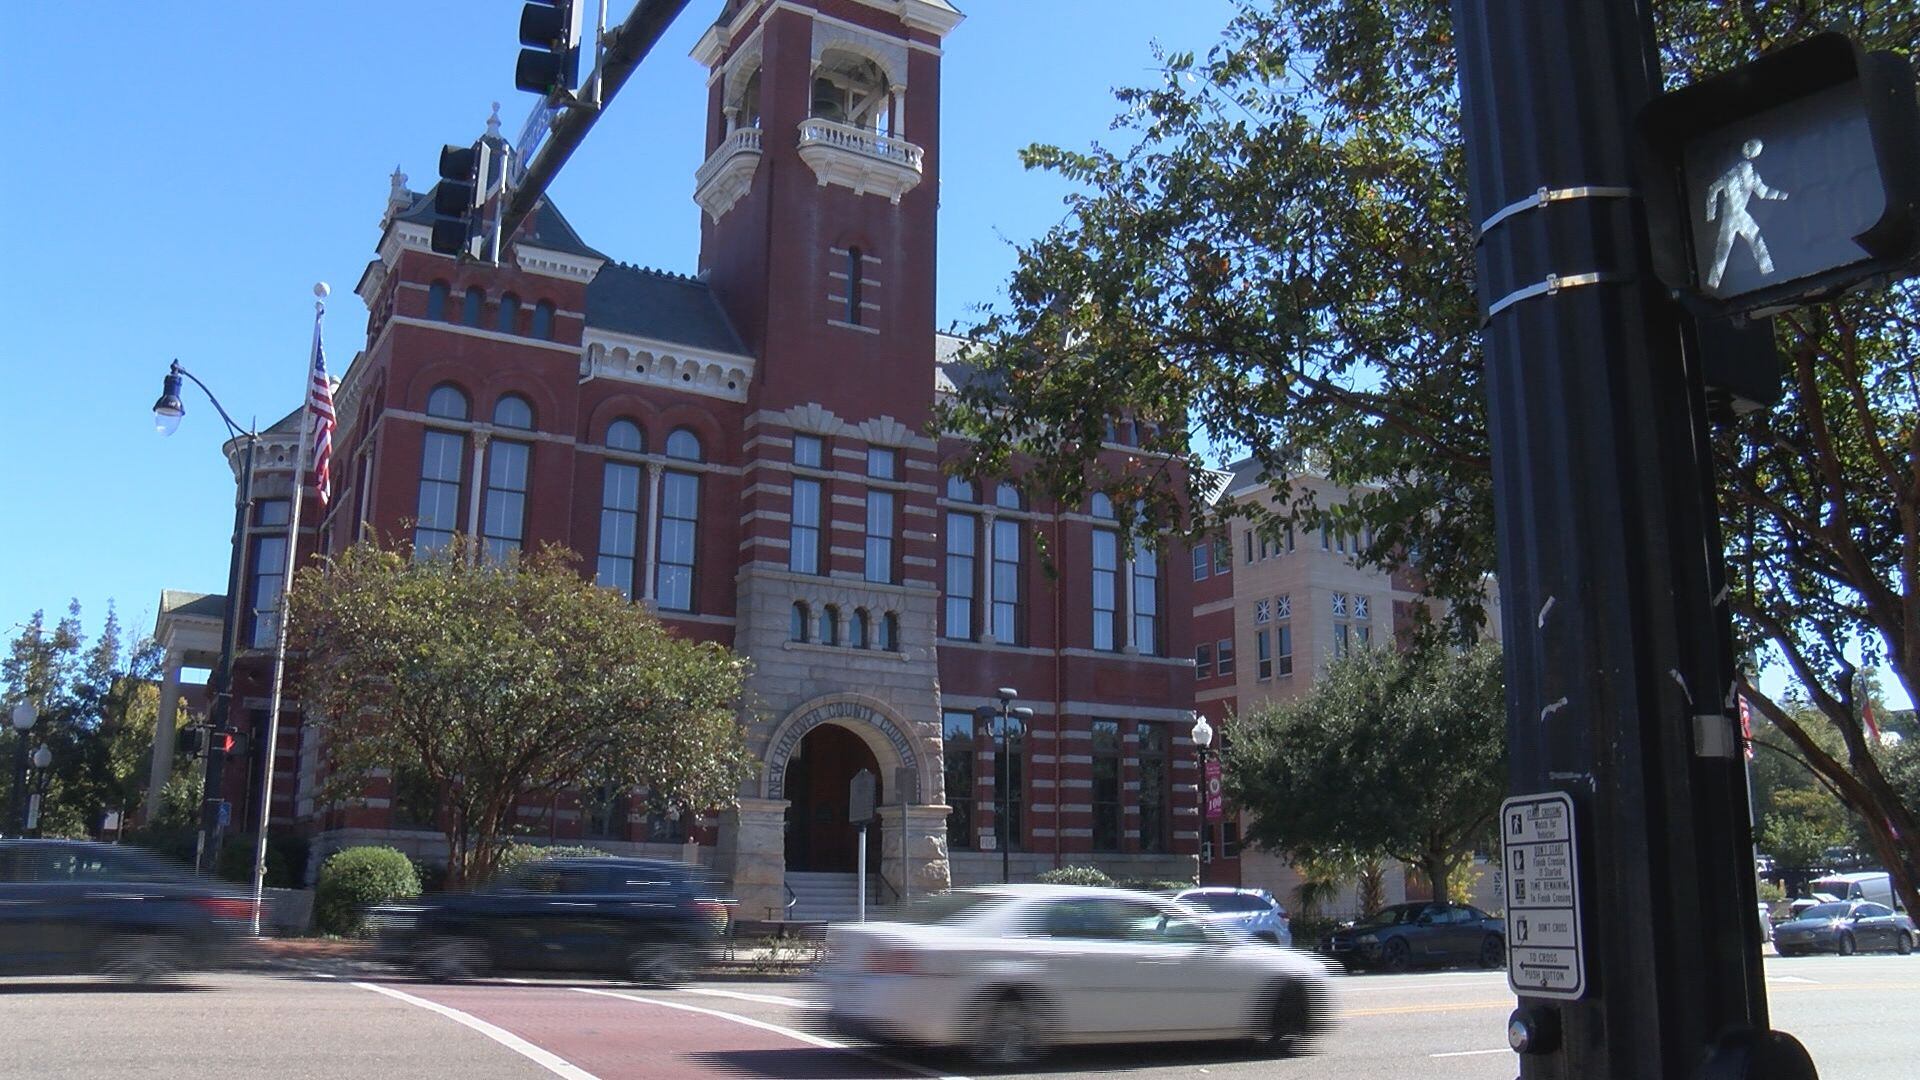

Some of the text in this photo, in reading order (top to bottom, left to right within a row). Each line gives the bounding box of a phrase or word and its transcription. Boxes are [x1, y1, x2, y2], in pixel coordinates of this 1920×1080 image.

[827, 703, 875, 721] COUNTY
[774, 709, 821, 757] HANOVER
[768, 763, 784, 800] NEW
[1529, 952, 1558, 963] TO CROSS
[1525, 970, 1565, 981] PUSH BUTTON
